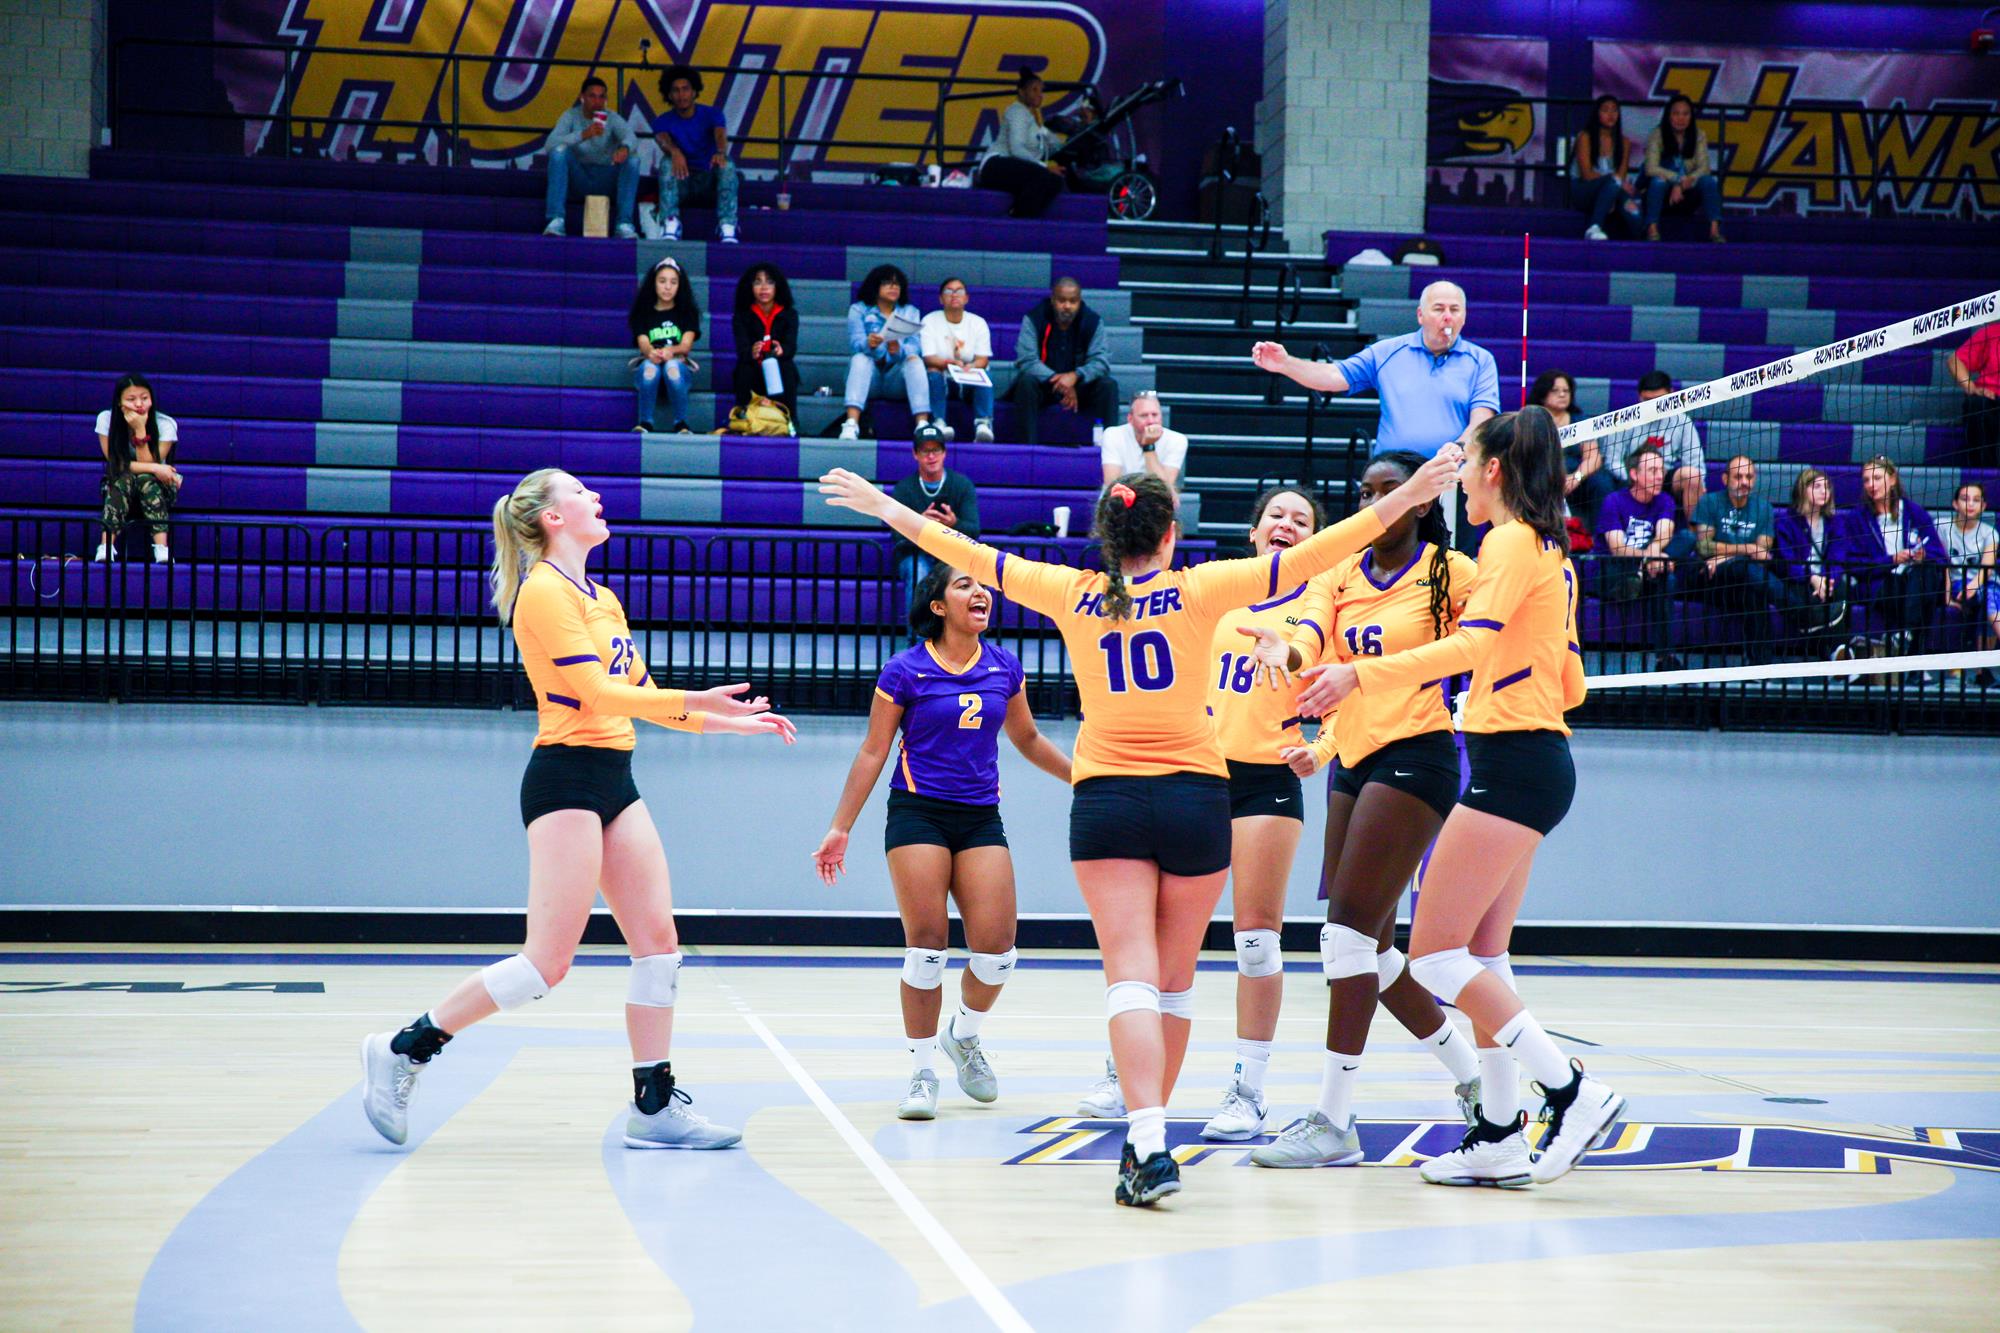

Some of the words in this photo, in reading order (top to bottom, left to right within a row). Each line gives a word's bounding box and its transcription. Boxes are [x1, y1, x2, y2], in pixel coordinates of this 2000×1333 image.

[272, 0, 1106, 174] HUNTER
[1912, 309, 1949, 336] HUNTER
[1962, 294, 1997, 322] HAWKS
[1813, 342, 1849, 365] HUNTER
[1856, 329, 1887, 354] HAWKS
[1730, 369, 1759, 392] HUNTER
[1766, 358, 1794, 381] HAWKS
[1619, 406, 1641, 424] HAWKS
[1655, 393, 1682, 413] HUNTER
[1687, 385, 1711, 404] HAWKS
[1073, 587, 1182, 620] HUTER
[608, 636, 634, 676] 25
[1344, 624, 1384, 657] 16
[1098, 628, 1176, 693] 10
[1217, 651, 1257, 694] 18
[958, 693, 983, 729] 2
